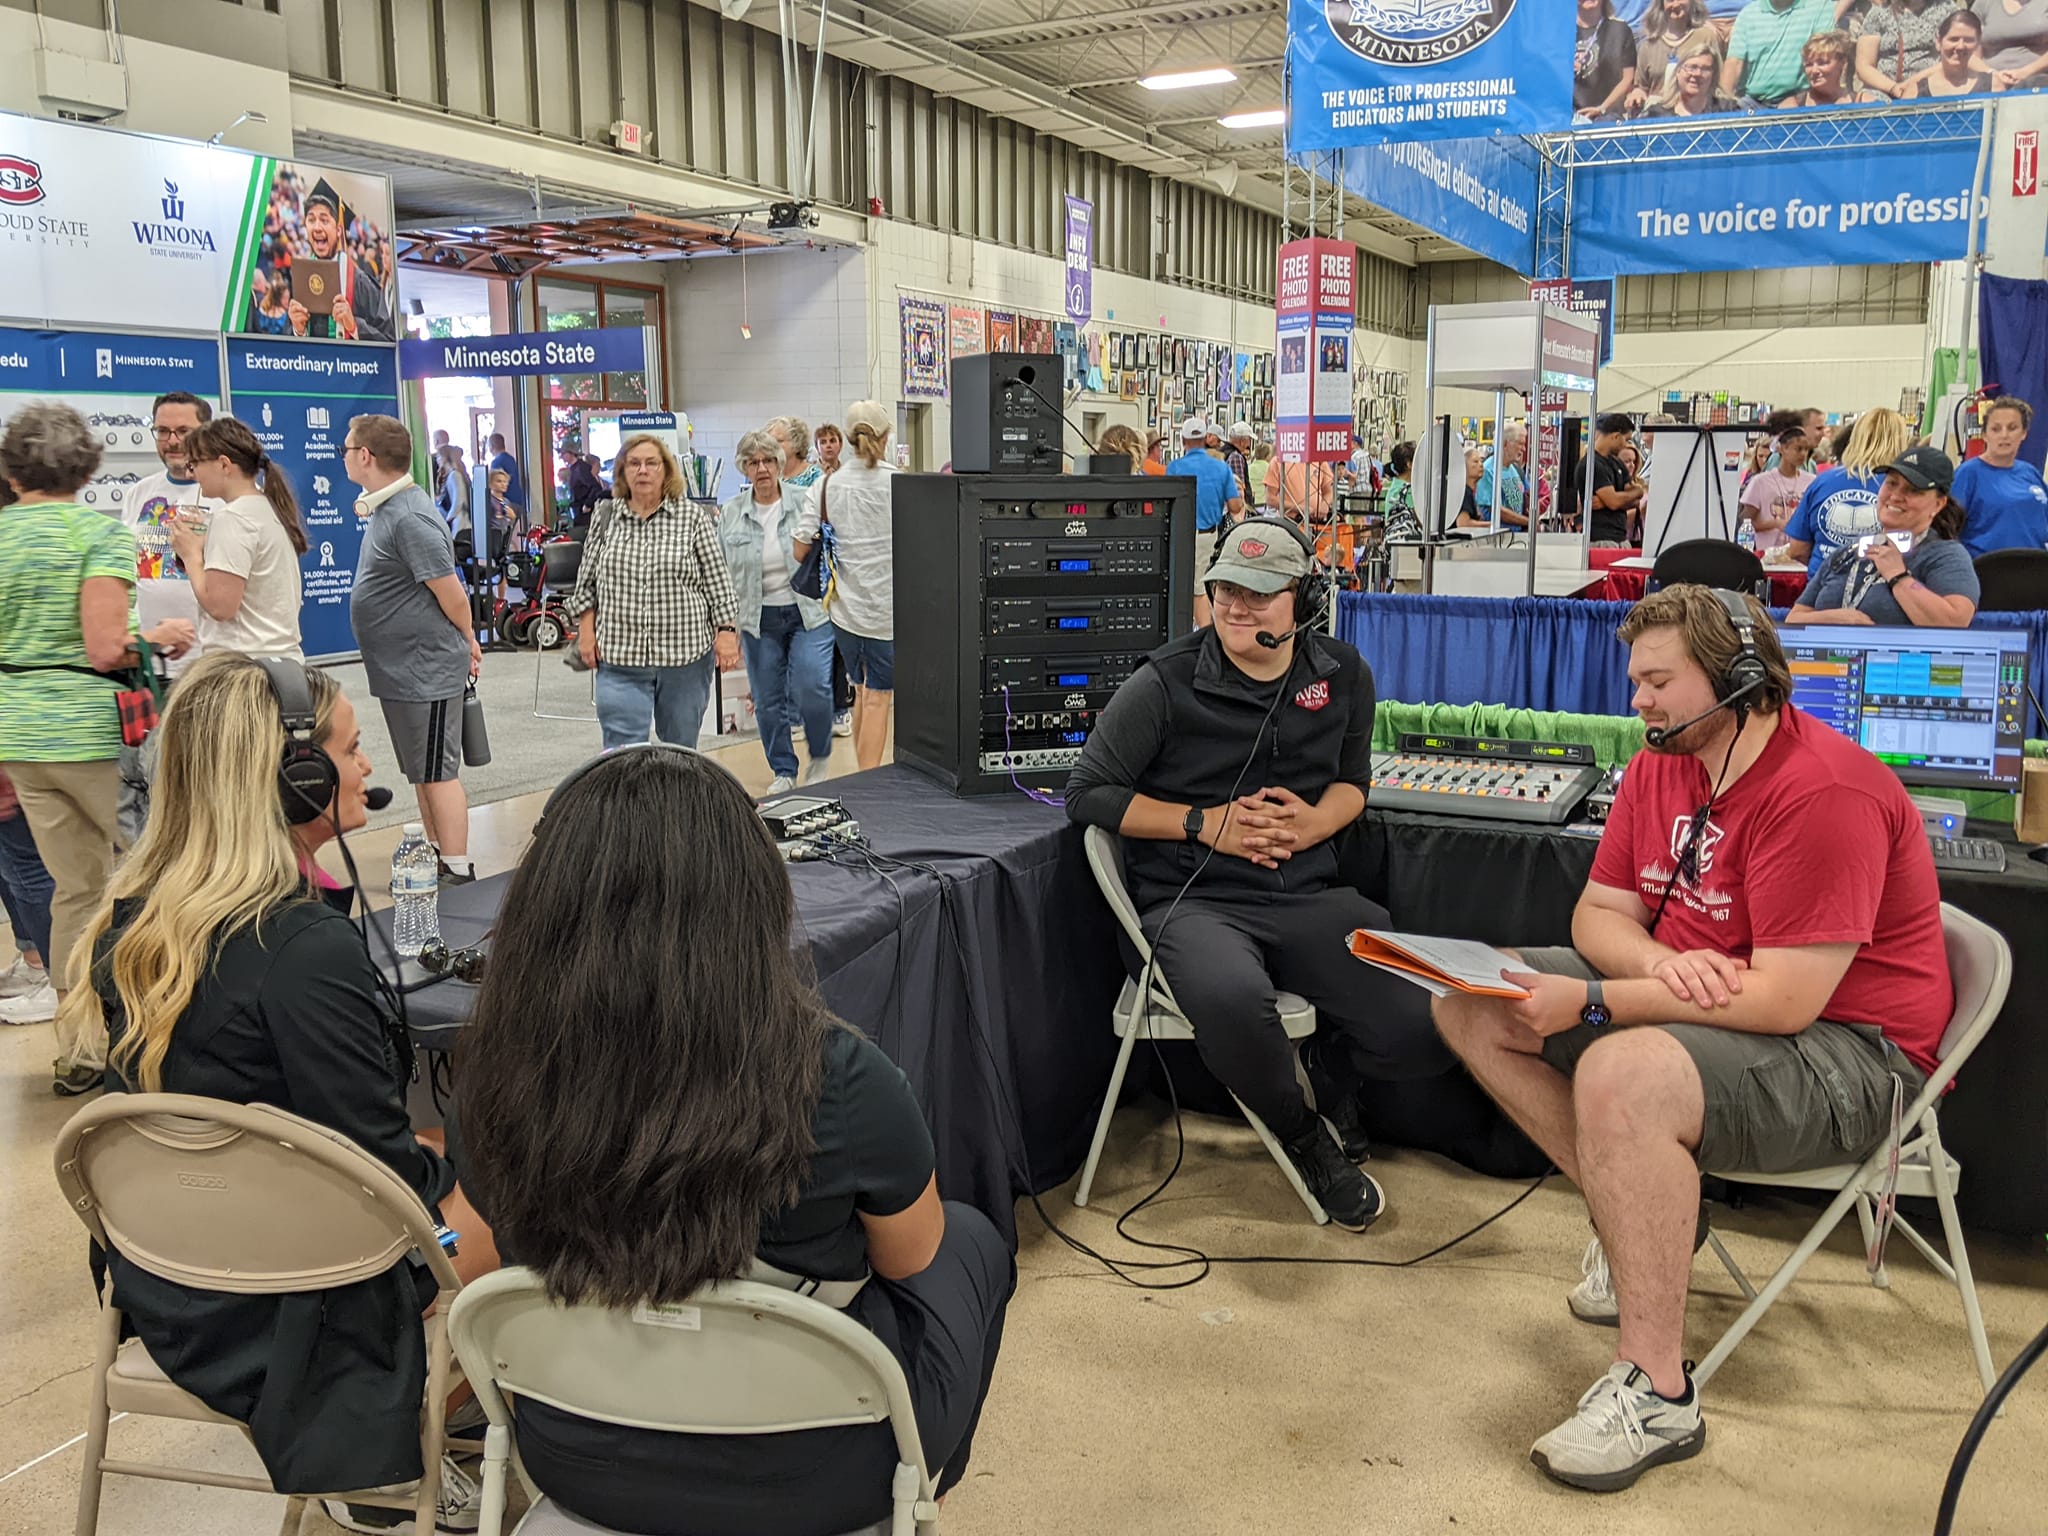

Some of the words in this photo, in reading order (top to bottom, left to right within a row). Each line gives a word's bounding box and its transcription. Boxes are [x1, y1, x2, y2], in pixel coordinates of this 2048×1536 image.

[1349, 20, 1491, 62] MINNESOTA
[1321, 90, 1345, 109] THE
[1347, 86, 1385, 106] VOICE
[1388, 84, 1413, 103] FOR
[1414, 77, 1516, 100] PROFESSIONAL
[1332, 106, 1404, 128] EDUCATORS
[1406, 103, 1433, 122] AND
[1436, 98, 1507, 119] STUDENTS
[625, 124, 638, 144] EXIT
[2018, 136, 2035, 147] FIRE
[38, 215, 89, 237] STATE
[1636, 207, 1690, 239] The
[1698, 202, 1777, 235] voice
[1784, 198, 1832, 230] for
[131, 220, 217, 253] WINONA
[1069, 232, 1087, 254] INFO
[150, 247, 168, 258] STATE
[168, 249, 203, 261] UNIVERSITY
[1067, 251, 1088, 272] DESK
[1282, 254, 1309, 280] FREE
[1320, 253, 1351, 278] FREE
[1282, 278, 1308, 297] PHOTO
[1320, 278, 1351, 295] PHOTO
[1531, 285, 1569, 302] FREE
[1281, 295, 1308, 309] CALENDAR
[1320, 295, 1350, 308] CALENDAR
[115, 354, 167, 367] MINNESOTA
[168, 356, 194, 369] STATE
[245, 352, 334, 376] Extraordinary
[336, 357, 379, 376] Impact
[444, 345, 541, 369] Minnesota
[545, 341, 596, 364] State
[622, 416, 655, 425] Minnesota
[655, 415, 673, 425] State
[305, 441, 336, 451] Academic
[1280, 431, 1306, 452] HERE
[1316, 430, 1348, 451] HERE
[306, 452, 336, 461] programs
[306, 516, 333, 526] financial
[333, 515, 344, 525] aid
[310, 507, 339, 516] Received
[330, 586, 353, 595] awarde
[1641, 882, 1683, 900] Makng
